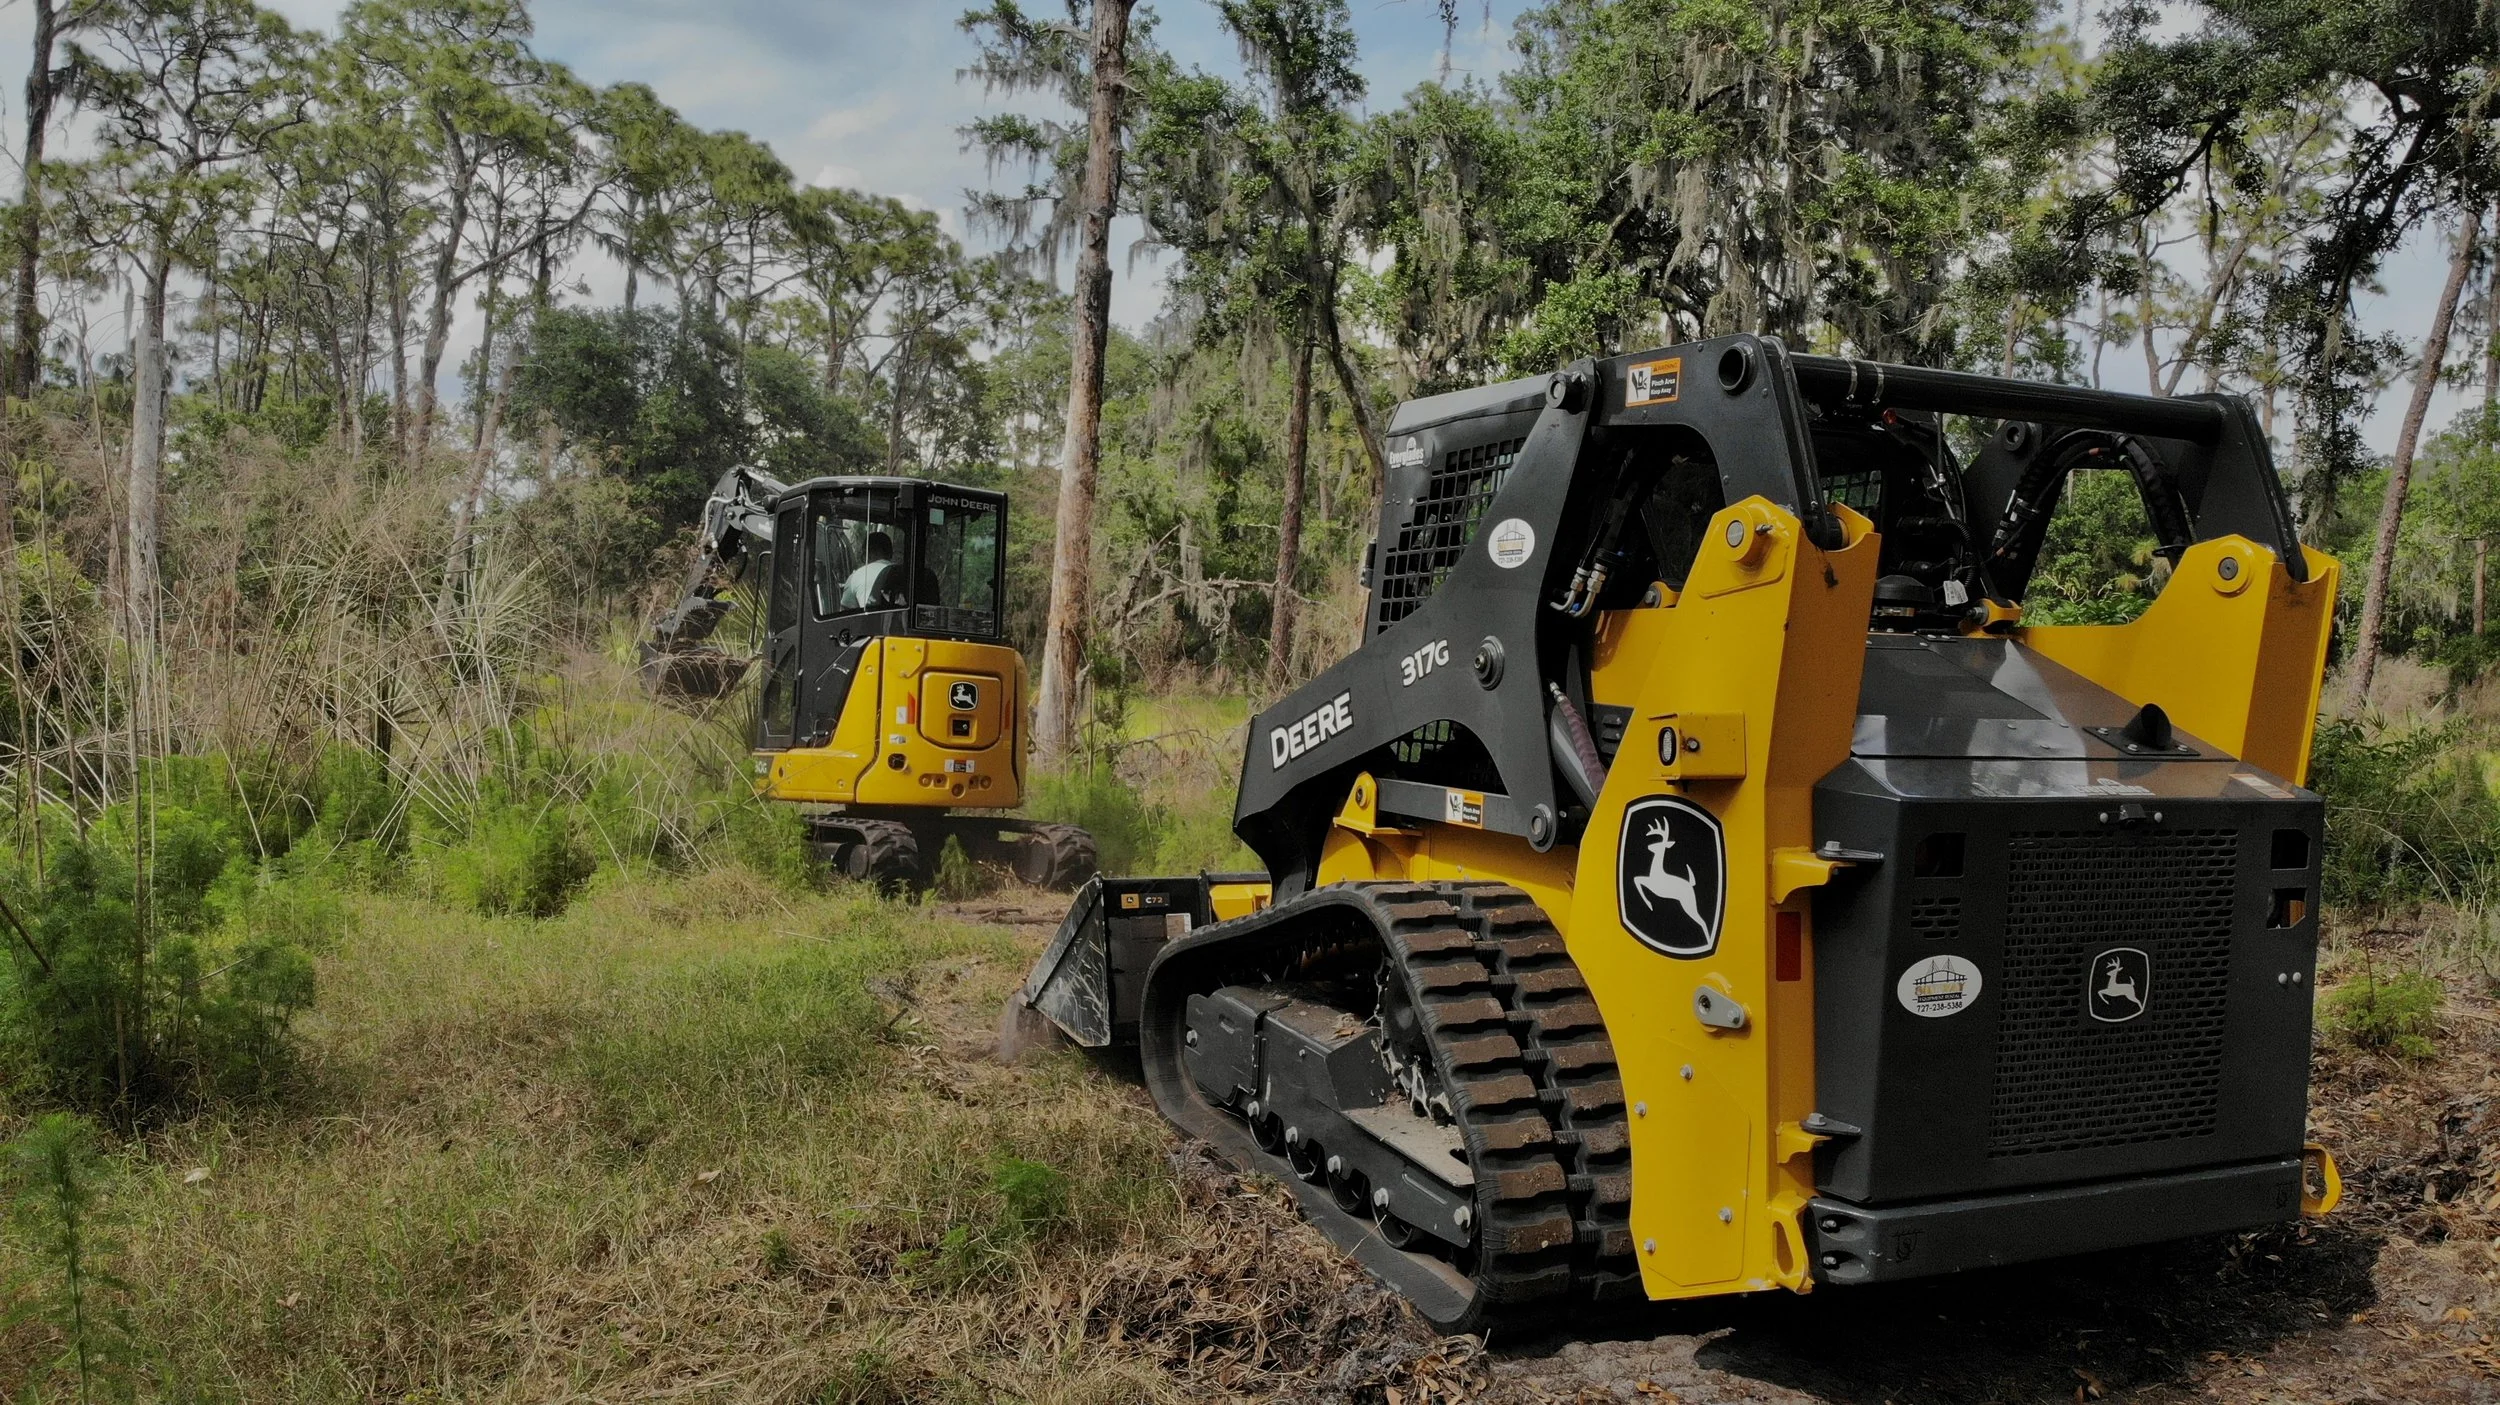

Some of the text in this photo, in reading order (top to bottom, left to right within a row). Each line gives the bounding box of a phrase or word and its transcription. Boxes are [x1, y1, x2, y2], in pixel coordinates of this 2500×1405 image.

[1651, 379, 1664, 387] Pinch
[927, 493, 998, 513] JOHN DEERE
[1400, 639, 1450, 687] 317G
[1270, 691, 1353, 770] DEERE
[1145, 896, 1164, 904] C72
